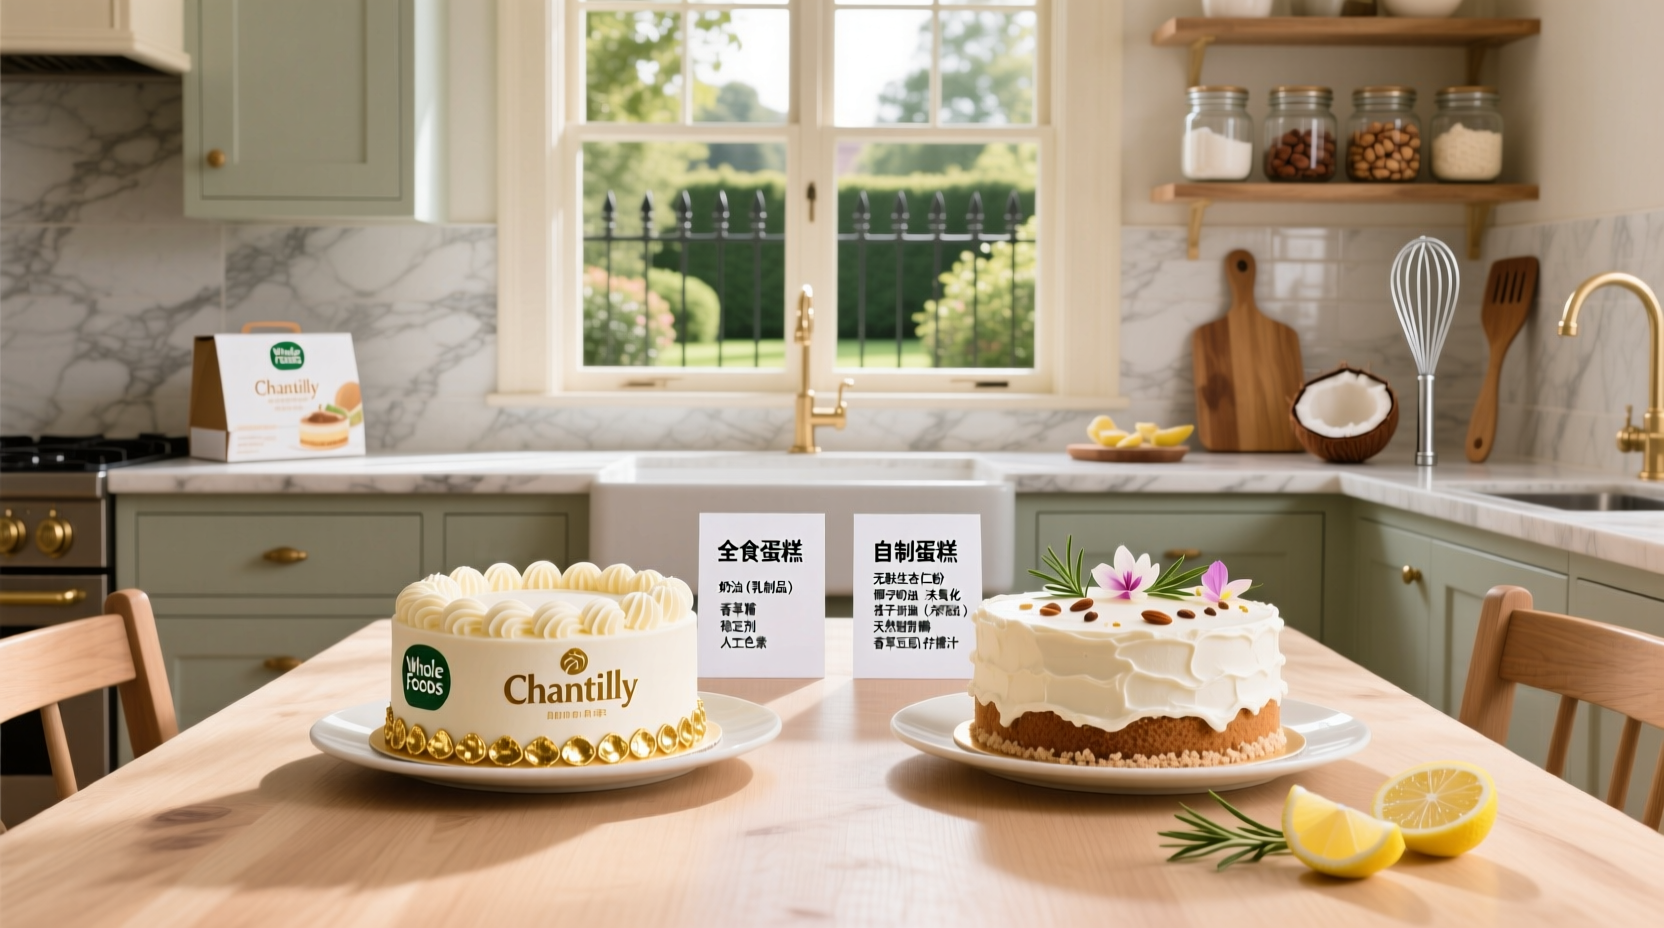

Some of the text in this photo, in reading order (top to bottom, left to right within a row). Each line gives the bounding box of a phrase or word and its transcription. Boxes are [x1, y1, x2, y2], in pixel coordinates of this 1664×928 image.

[255, 379, 319, 399] Chantilly
[718, 539, 803, 563] 全食蛋糕
[874, 539, 958, 563] 自制蛋糕
[406, 655, 445, 679] Whole
[504, 670, 639, 708] Chantilly
